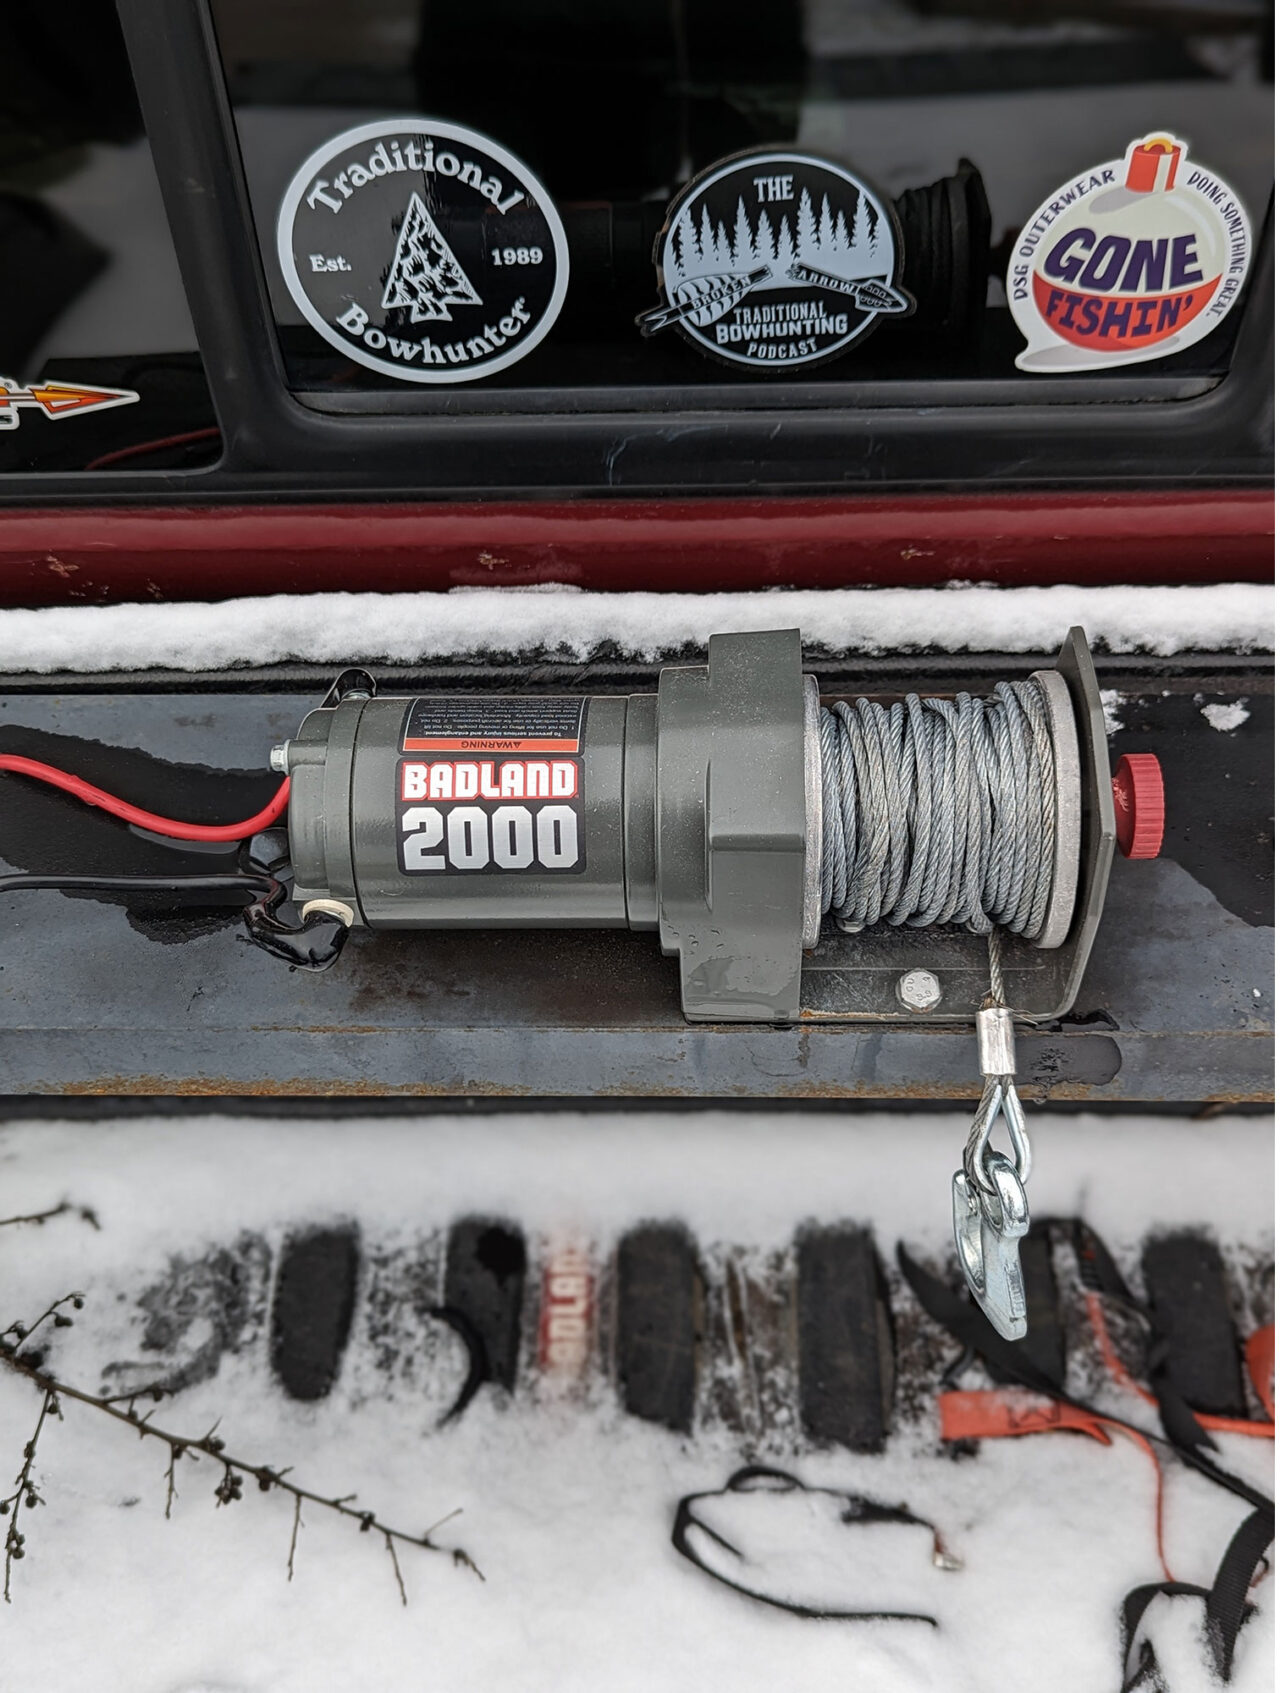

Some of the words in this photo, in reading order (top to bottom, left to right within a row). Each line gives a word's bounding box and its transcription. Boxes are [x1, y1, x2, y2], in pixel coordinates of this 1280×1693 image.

[306, 141, 525, 215] Traditional
[753, 174, 794, 203] THE
[1018, 168, 1116, 258] OUTERWEAR
[1186, 170, 1225, 206] DOING
[1220, 202, 1246, 274] SOMETHING
[309, 253, 352, 272] Est.
[491, 247, 543, 266] 1989
[1043, 226, 1204, 293] GONE
[691, 276, 752, 310] BROKEN
[798, 266, 857, 294] ARROW
[1013, 263, 1029, 301] DSG
[715, 313, 848, 345] BOWHUNTING
[733, 300, 827, 325] TRADITIONAL
[1043, 288, 1194, 339] FISHIN'
[335, 304, 533, 365] Bowhunter
[746, 336, 818, 360] PODCAST
[461, 741, 514, 749] WARNING
[402, 760, 578, 800] BADLAND
[402, 805, 579, 870] 2000
